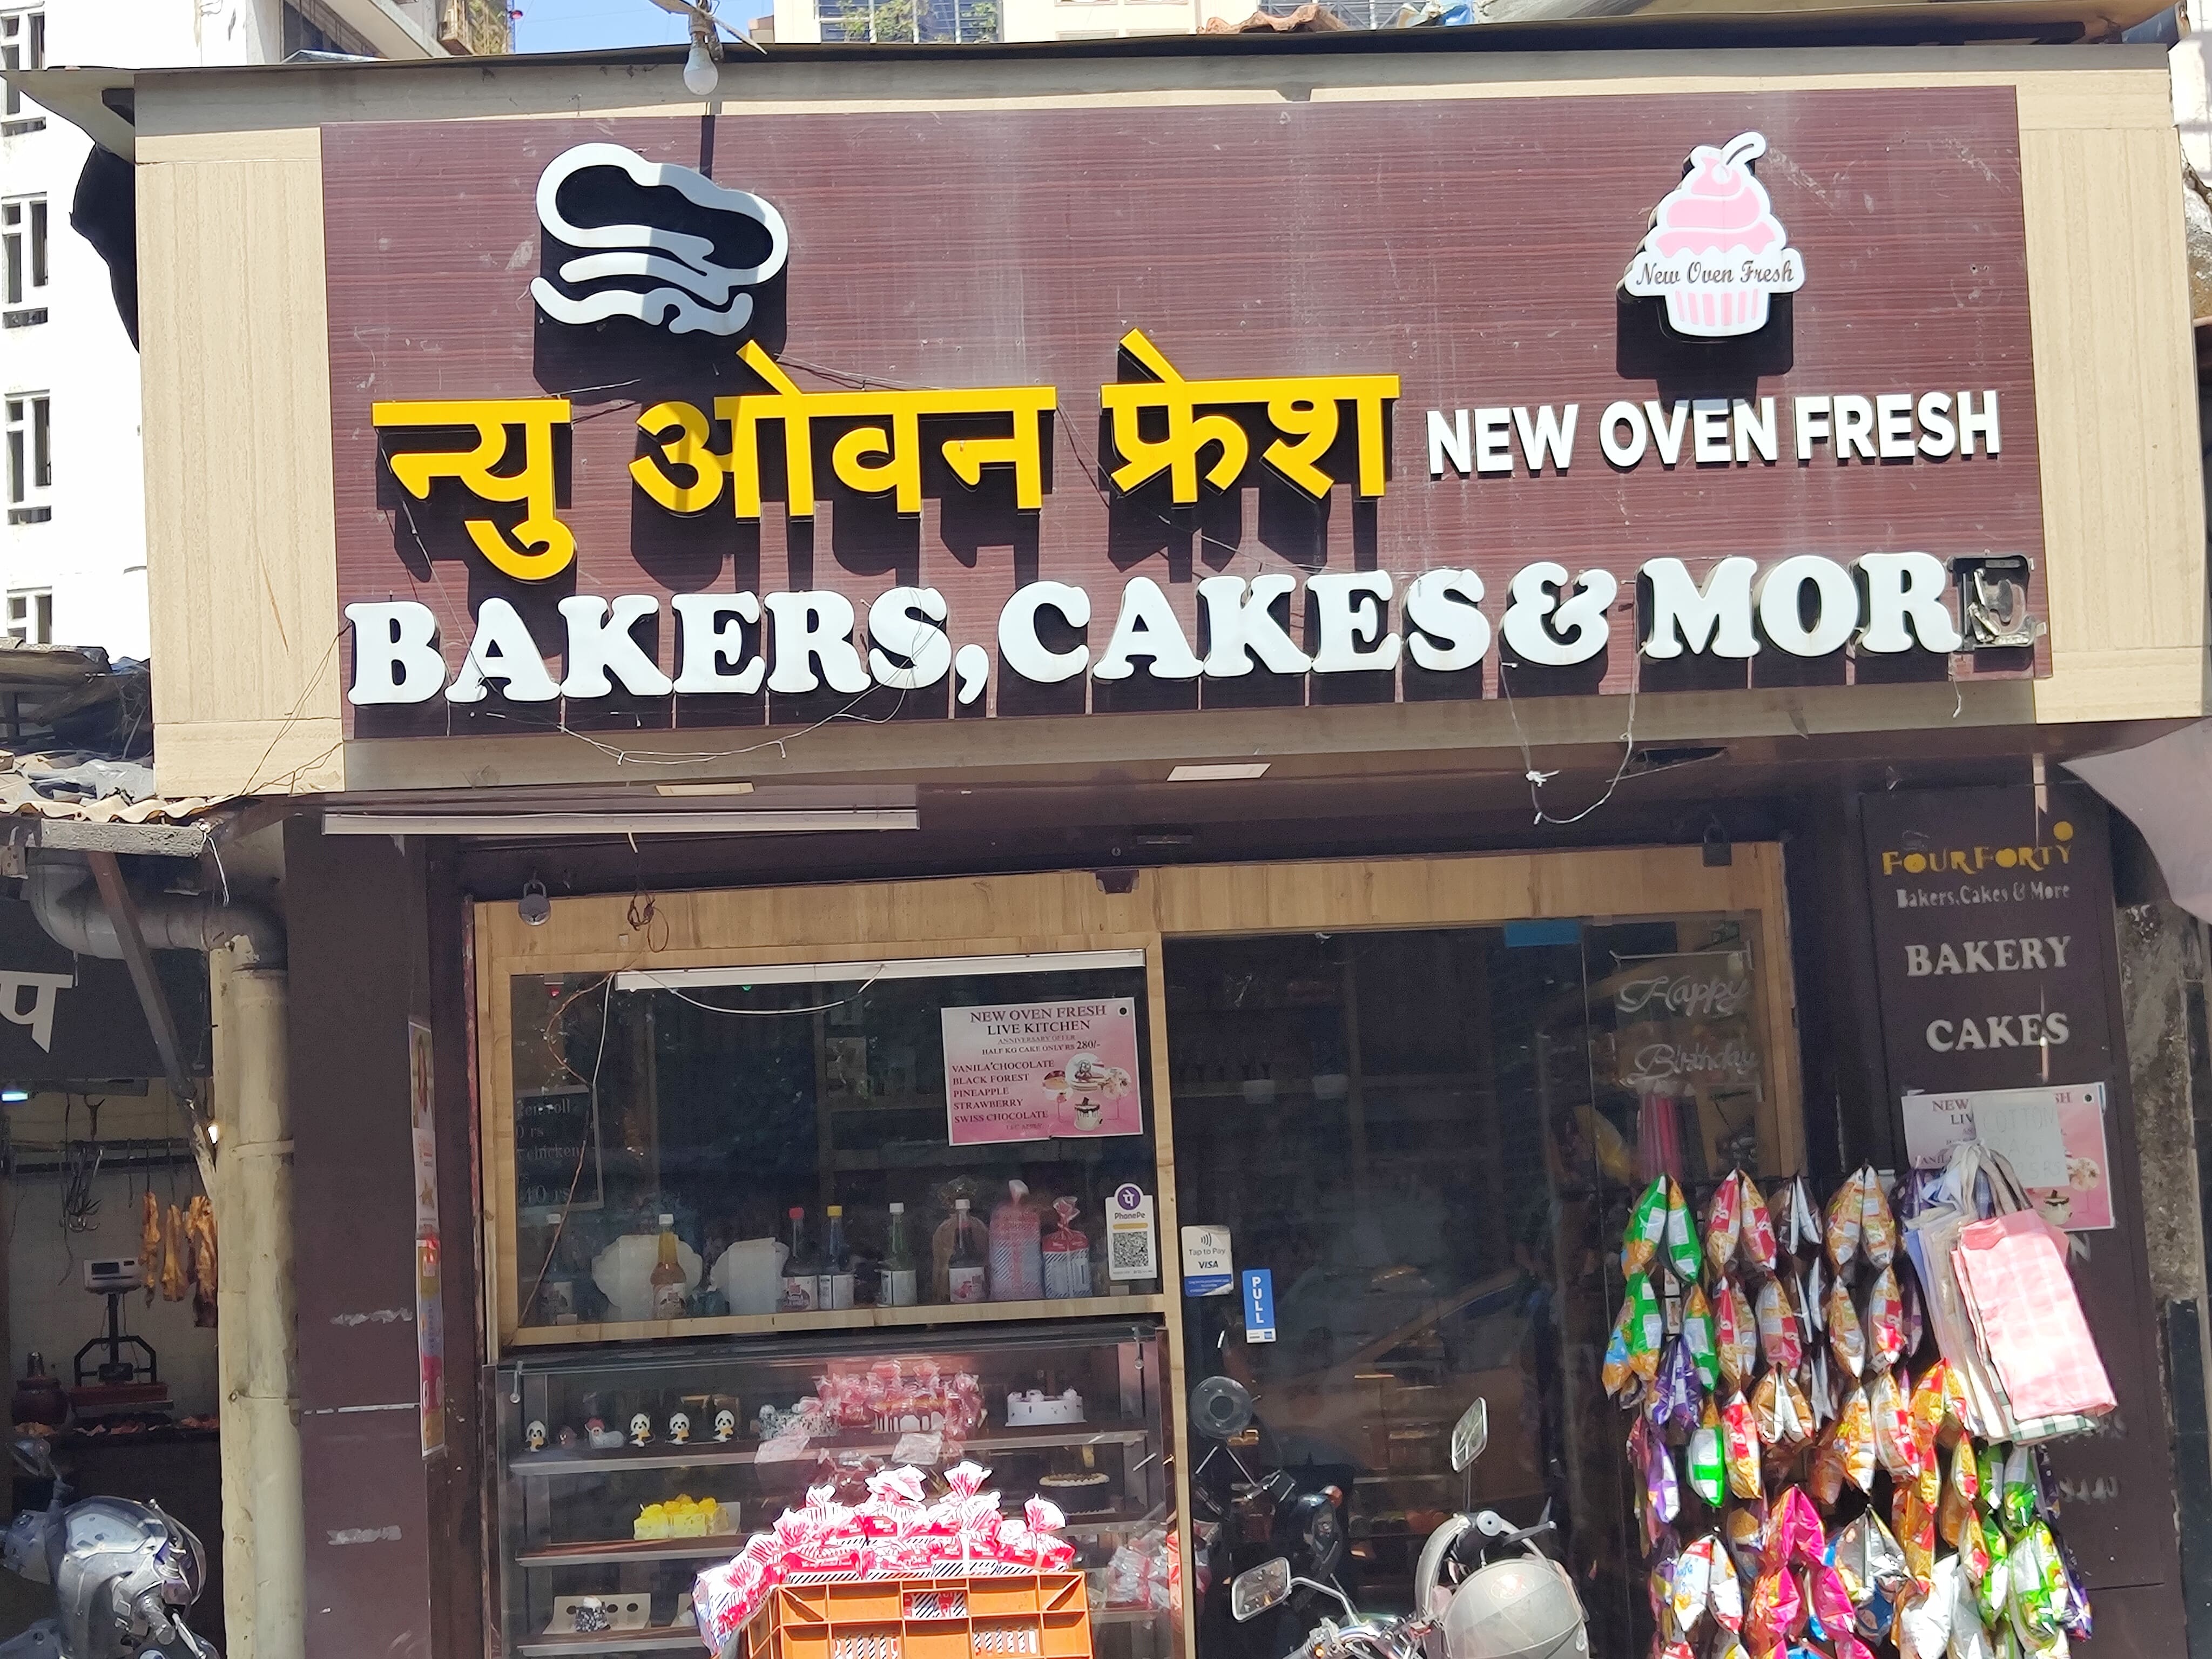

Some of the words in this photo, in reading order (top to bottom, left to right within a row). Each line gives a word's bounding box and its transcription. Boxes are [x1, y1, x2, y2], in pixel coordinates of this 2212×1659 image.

[1636, 262, 1681, 286] New
[1687, 260, 1734, 283] Oven
[1740, 260, 1795, 282] Fresh
[1426, 404, 1579, 476] NEW
[1600, 397, 1778, 469] OVEN
[1794, 390, 2000, 462] FRESH
[372, 399, 576, 581] न्यु
[628, 339, 1058, 520] ओवन
[1101, 327, 1401, 505] फ्रेश
[2031, 880, 2071, 900] More
[1905, 935, 2072, 977] BAKERY
[1616, 975, 1749, 1017] Happy
[970, 1011, 1006, 1023] NEW
[1009, 1009, 1053, 1021] OVEN
[1057, 1005, 1107, 1018] FRESH
[987, 1024, 1021, 1036] LIVE
[1024, 1020, 1091, 1034] KITCHEN
[1926, 1012, 2070, 1053] CAKES
[1019, 1045, 1040, 1053] CAKE
[1076, 1040, 1101, 1050] 280/-
[1626, 1043, 1757, 1084] Birthday
[953, 1076, 987, 1085] BLACK
[990, 1073, 1029, 1083] FOREST
[953, 1087, 1010, 1098] PINEAPPLE
[953, 1098, 1023, 1110] STRAWBERRY
[1932, 1098, 1969, 1112] NEW
[954, 1114, 984, 1123] SWISS
[986, 1110, 1049, 1122] CHOCOLATE
[1951, 1113, 1974, 1125] LIV
[1114, 1211, 1145, 1219] PhonePe
[1212, 1247, 1226, 1256] Pay
[1198, 1260, 1219, 1269] VISA
[1252, 1276, 1265, 1324] PULL
